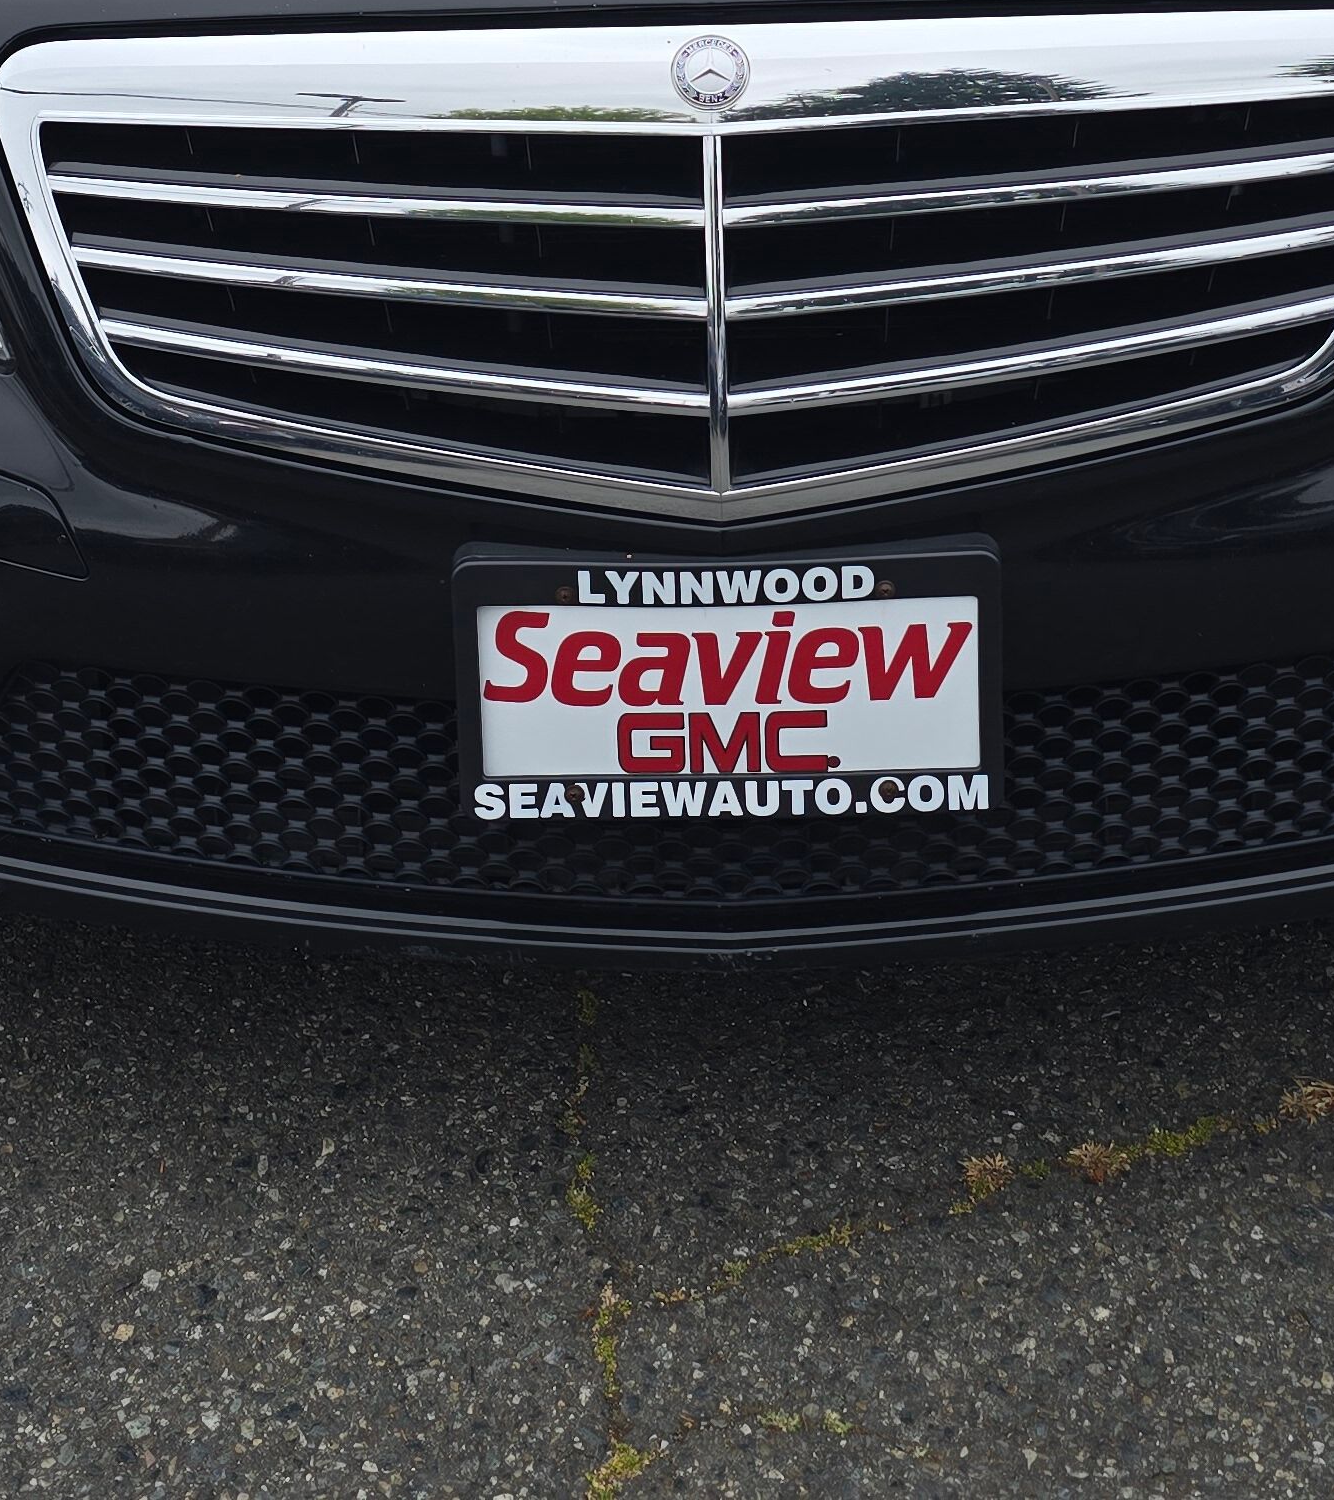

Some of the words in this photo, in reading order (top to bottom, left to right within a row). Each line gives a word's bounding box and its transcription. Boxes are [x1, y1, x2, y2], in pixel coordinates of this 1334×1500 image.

[577, 565, 875, 605] LYNNWOOD
[482, 610, 973, 707] Seaview
[616, 710, 829, 774] GMC
[473, 774, 990, 820] SEAVIEWAUTO.COM
